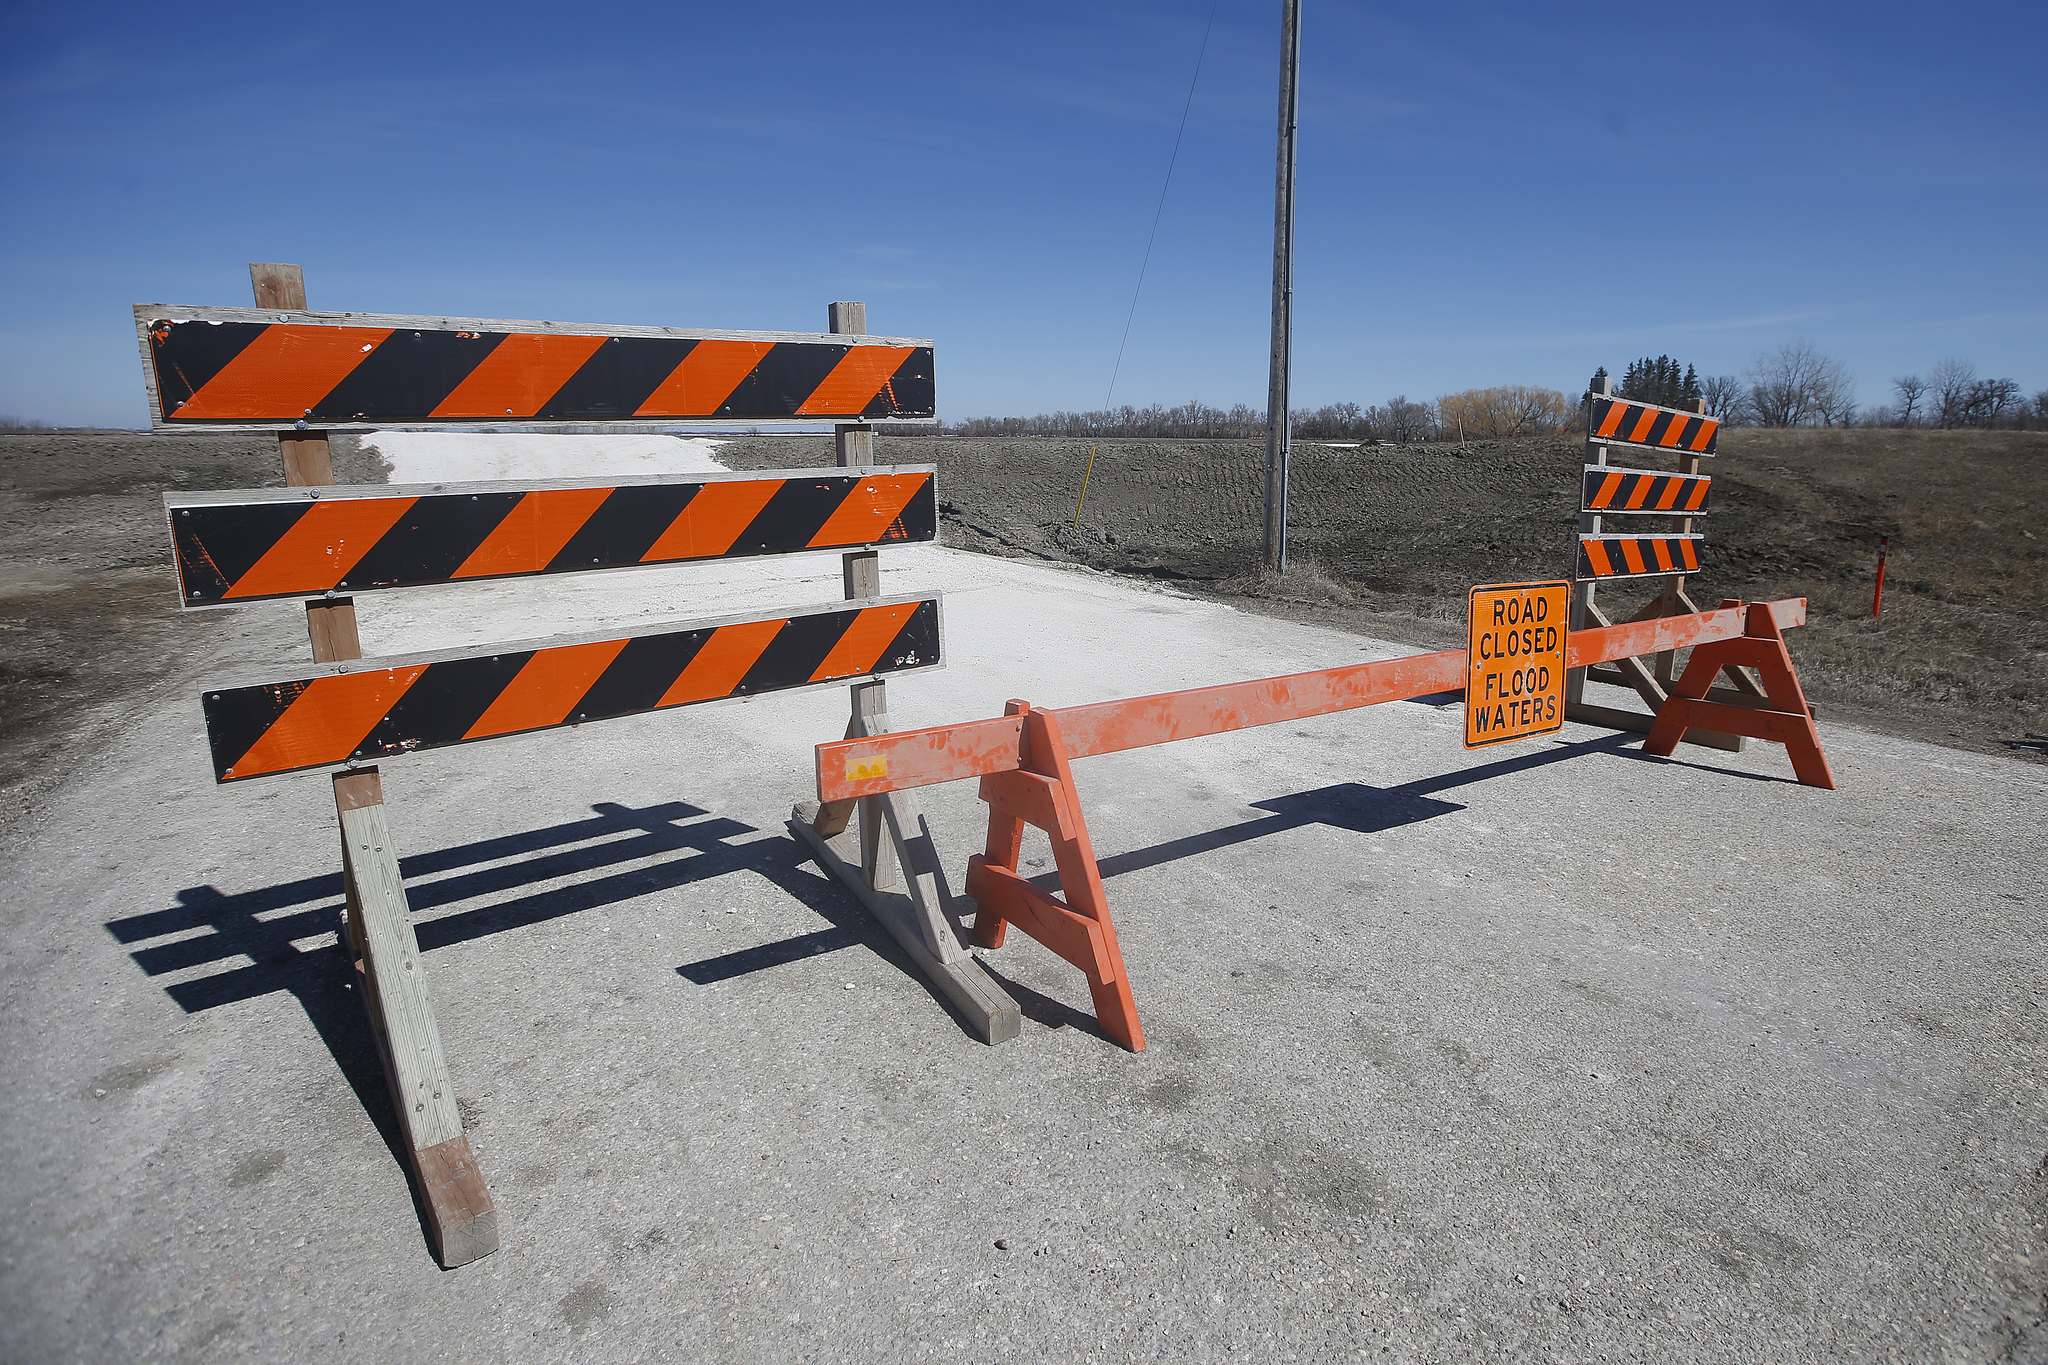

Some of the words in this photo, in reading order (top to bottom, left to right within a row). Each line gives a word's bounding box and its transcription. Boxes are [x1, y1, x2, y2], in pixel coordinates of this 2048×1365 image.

[1493, 597, 1548, 626] ROAD
[1480, 627, 1557, 660] CLOSED
[1485, 666, 1549, 700] FLOOD
[1475, 695, 1557, 734] WATERS
